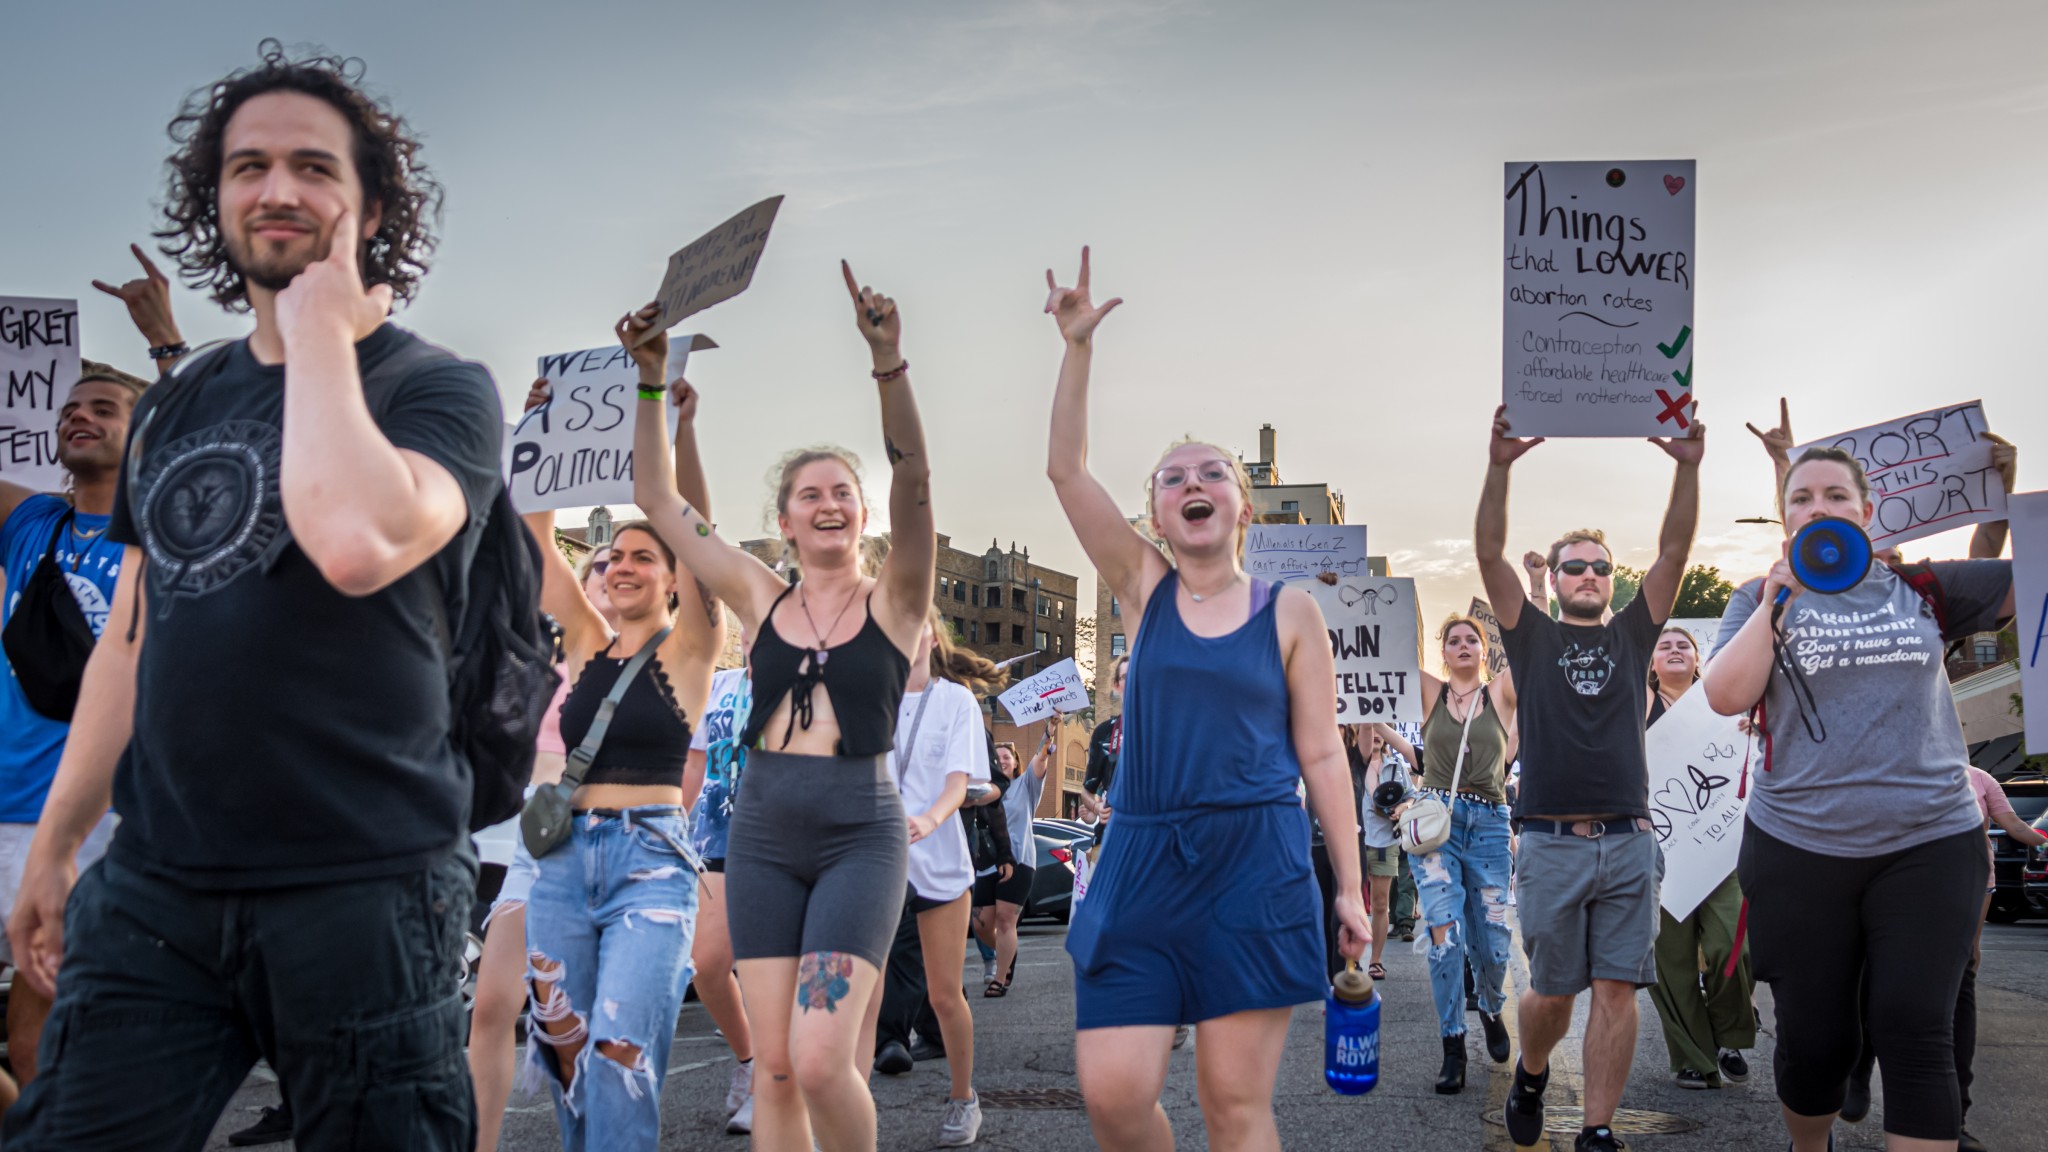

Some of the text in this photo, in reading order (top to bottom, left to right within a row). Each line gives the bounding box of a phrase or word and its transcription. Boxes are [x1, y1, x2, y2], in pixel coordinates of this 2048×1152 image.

[1506, 163, 1647, 259] Things
[1506, 243, 1689, 290] that LOWER
[1510, 284, 1653, 312] abortion rates
[1522, 328, 1642, 361] Contraception
[543, 346, 639, 377] WEA
[1523, 356, 1670, 383] affordable healthcare
[7, 359, 57, 410] MY
[1519, 381, 1652, 404] forced motherhood
[513, 384, 625, 436] ASS
[1832, 404, 1979, 474] BORT
[1871, 462, 1938, 492] THIS
[1873, 466, 1996, 534] OURT
[1305, 533, 1329, 551] Gen
[1332, 536, 1347, 550] Z
[1795, 601, 1896, 625] Against
[1785, 617, 1915, 645] Abortion?
[1797, 635, 1923, 656] Don't have one
[1800, 655, 1834, 676] Get
[1838, 656, 1851, 667] a
[1855, 649, 1931, 666] vasectomy
[1379, 671, 1407, 695] IT
[1358, 696, 1398, 720] DO!
[1703, 824, 1721, 839] TO
[1721, 805, 1740, 823] ALL
